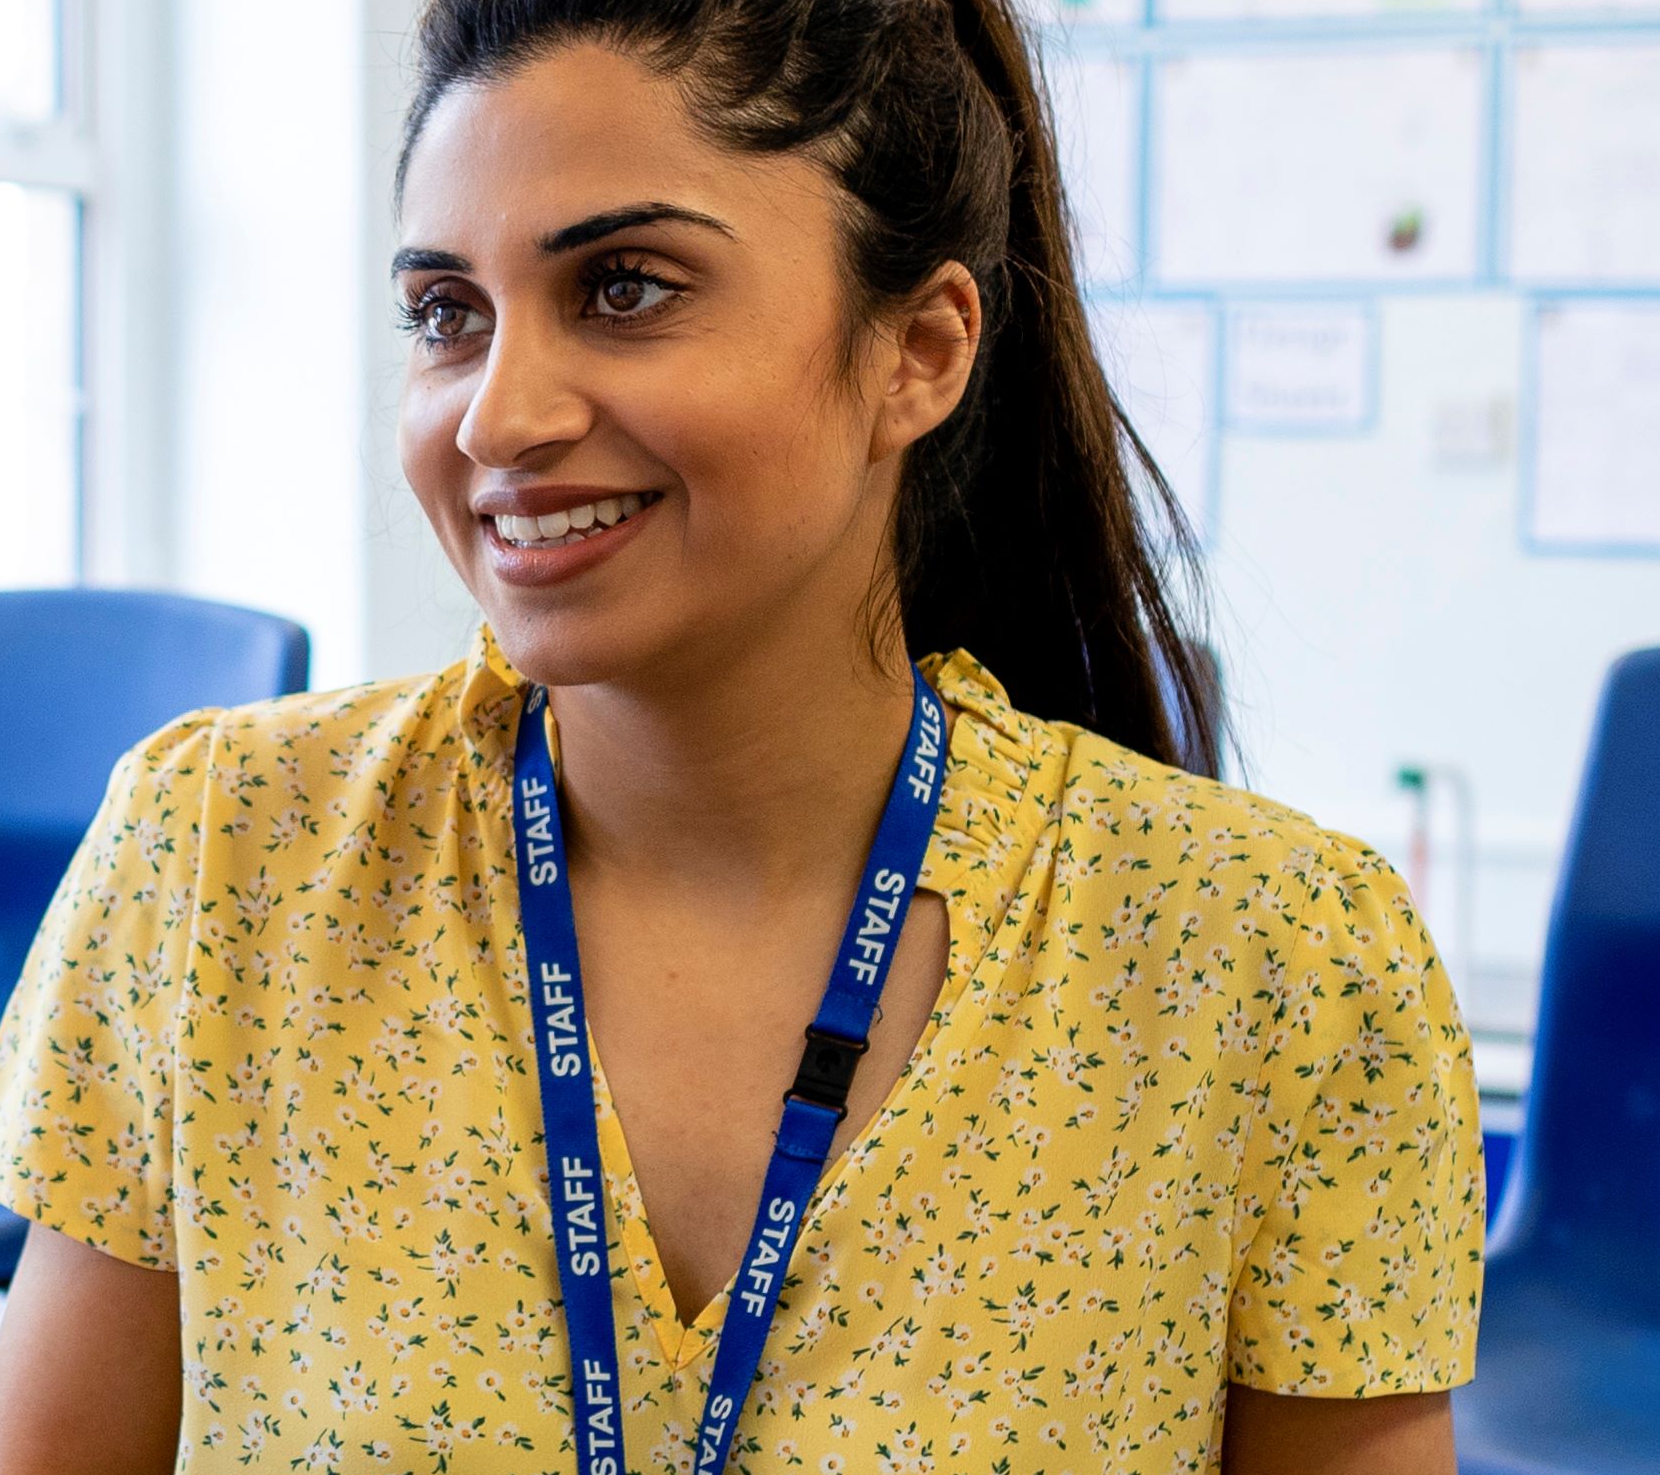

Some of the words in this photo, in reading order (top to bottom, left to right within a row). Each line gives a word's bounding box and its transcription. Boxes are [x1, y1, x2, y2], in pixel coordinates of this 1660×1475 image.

[906, 696, 943, 805] STAFF
[522, 776, 558, 886] STAFF
[849, 868, 906, 986] STAFF
[541, 963, 581, 1077] STAFF
[562, 1157, 601, 1277] STAFF
[740, 1197, 796, 1318] STAFF
